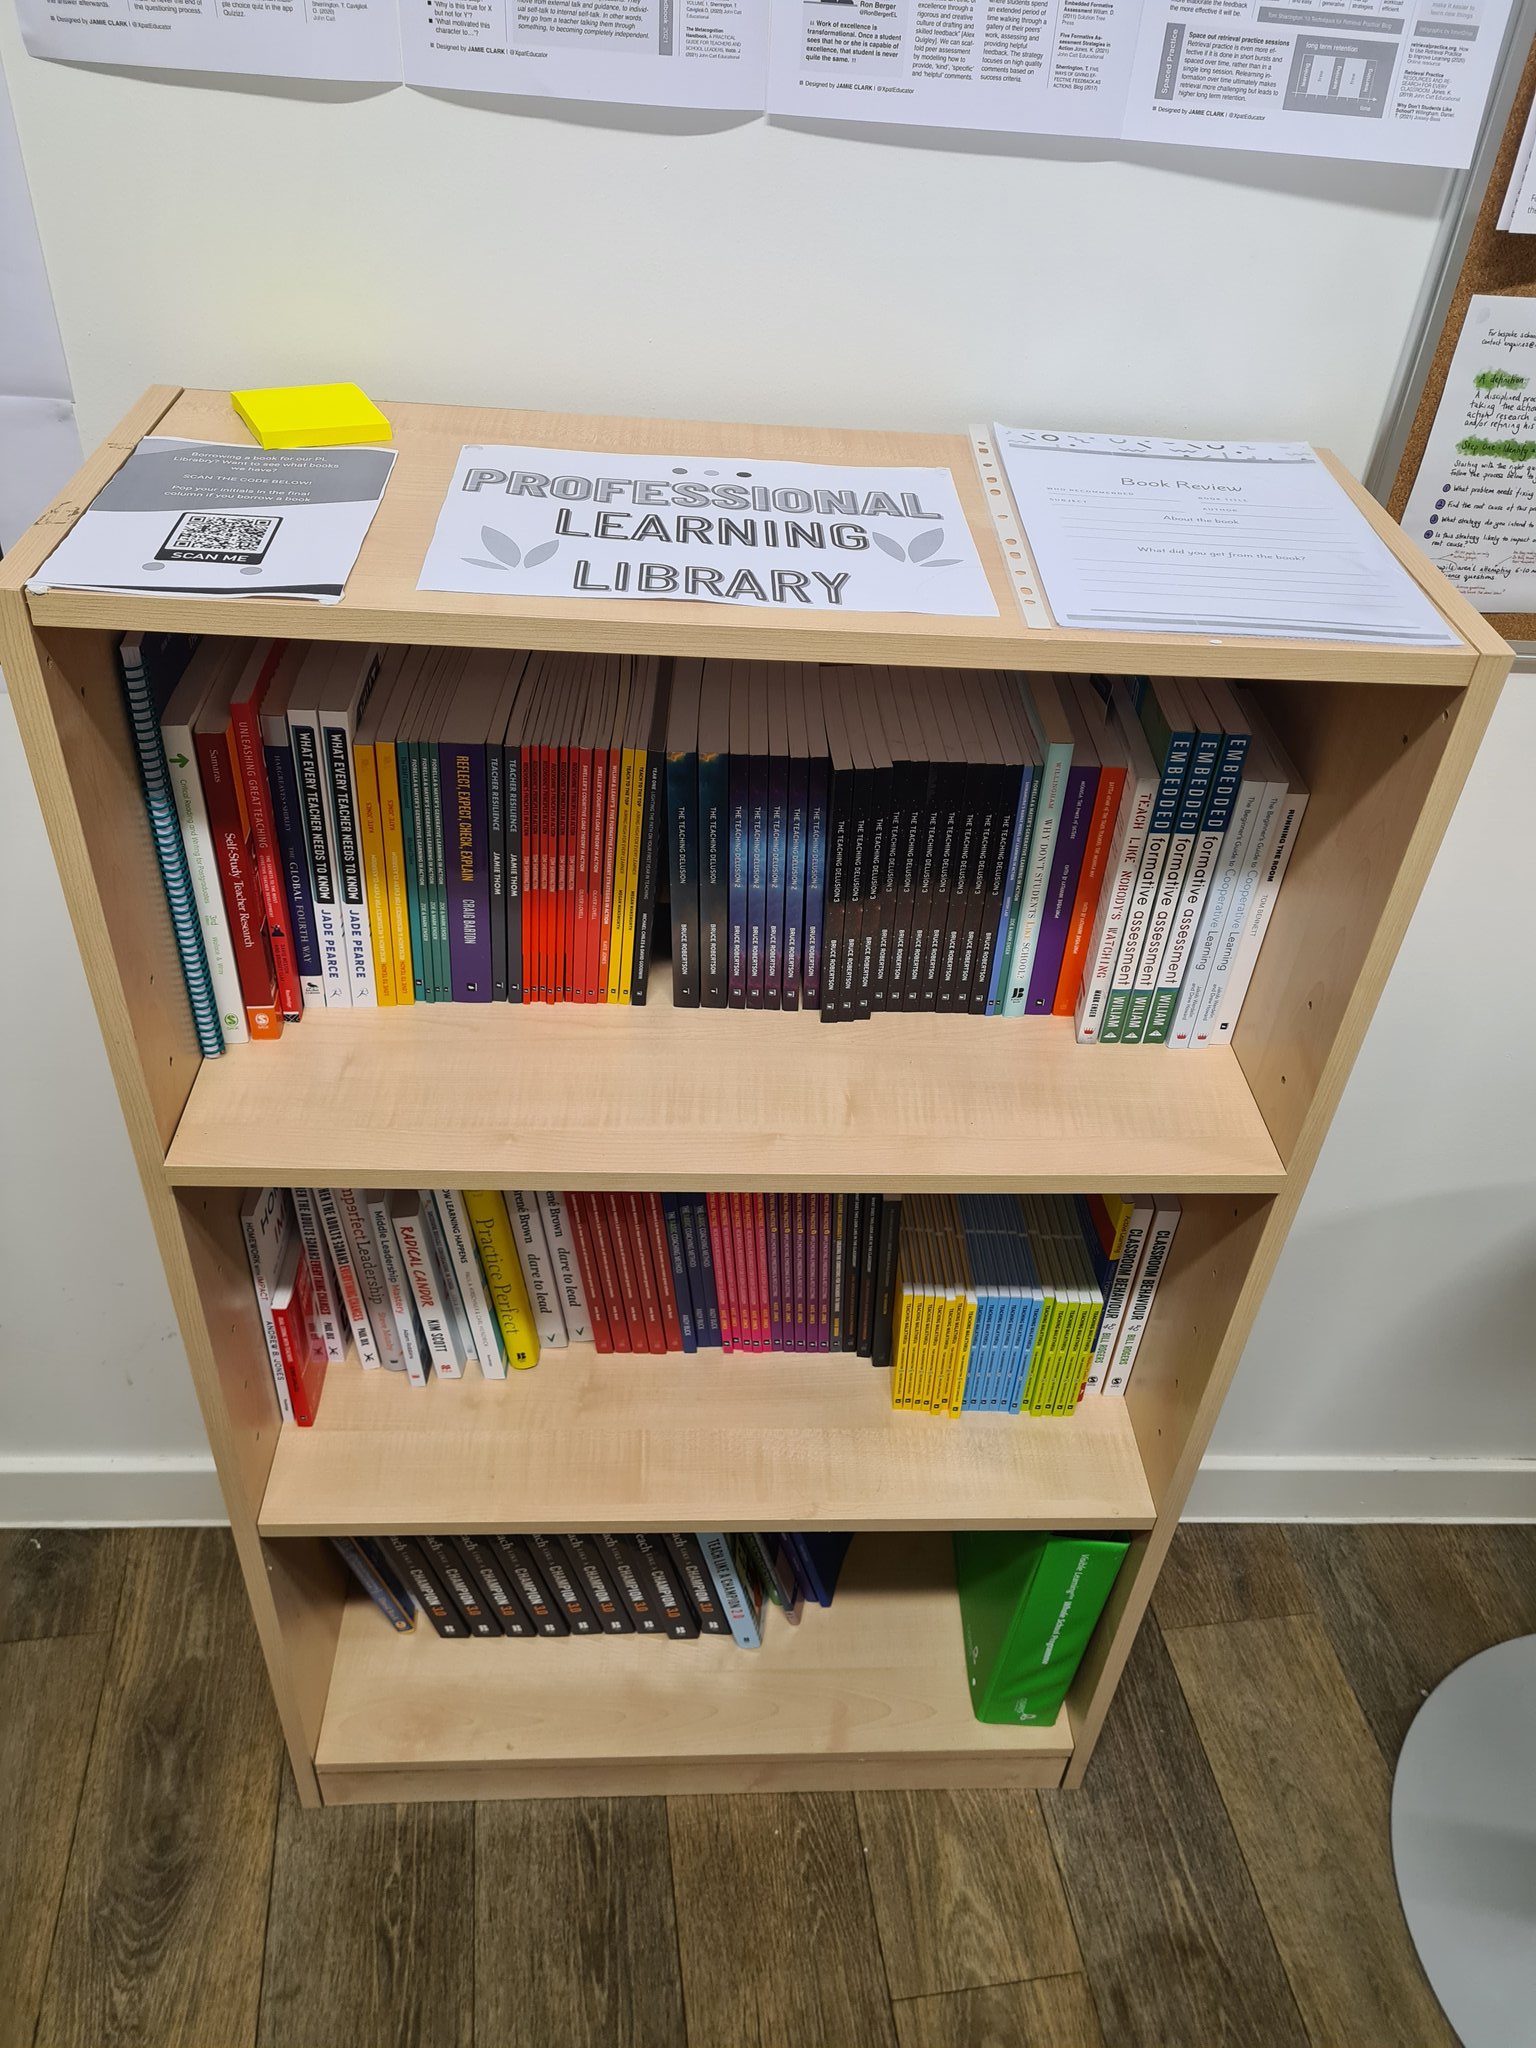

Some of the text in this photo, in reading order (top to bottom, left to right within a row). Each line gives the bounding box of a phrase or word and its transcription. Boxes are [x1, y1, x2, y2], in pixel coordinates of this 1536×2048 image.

[875, 2, 896, 10] Berger
[1218, 34, 1240, 42] retrieval
[1241, 36, 1264, 44] practice
[1161, 29, 1178, 94] Spaced Practice
[192, 452, 242, 460] Borrowing
[462, 468, 944, 520] PROFESSIONAL
[1121, 477, 1242, 492] Book Review
[1462, 501, 1471, 509] the
[1470, 486, 1494, 495] problem
[1515, 488, 1534, 500] fixing
[554, 508, 869, 551] LEARNING
[171, 552, 249, 563] SCAN ME
[572, 559, 852, 605] LIBRARY
[209, 750, 221, 783] Samaras
[239, 721, 268, 848] UNLEASHING GREAT TEACHING
[491, 757, 499, 790] TEACHER
[299, 732, 330, 900] WHAT EVERY TEACHER NEEDS TO KNOW
[331, 734, 359, 900] WHAT EVERY TEACHER NEEDS TO KNOW
[456, 755, 474, 881] REFLECT, EXPECT, CHECK, EXPLAIN
[678, 822, 686, 853] TEACHING
[1042, 819, 1053, 840] WHY
[1036, 844, 1048, 871] DON'T
[1118, 741, 1190, 986] EMBEDDED formative assessment
[1140, 742, 1217, 986] EMBEDDED formative assessment
[1165, 740, 1247, 984] EMBEDDED formative assessment
[1267, 809, 1295, 882] RUNNING THE ROOM
[225, 833, 254, 948] Self-Study Teacher Research
[289, 862, 303, 901] GLOBAL
[1028, 873, 1042, 919] STUDENTS
[1096, 793, 1152, 979] TEACH LIKE NOBODY'S WATCHING
[296, 905, 309, 942] FOURTH
[321, 909, 339, 978] JADE PEARCE
[463, 899, 476, 944] CRAIG BARTON
[302, 946, 312, 962] WAY
[350, 910, 366, 978] JADE PEARCE
[1017, 942, 1030, 979] SCHOOL?
[1108, 997, 1125, 1027] WILIAM
[1128, 997, 1147, 1028] WILIAM
[1153, 994, 1172, 1025] WILIAM
[400, 1227, 434, 1307] RADICAL CANDOR
[476, 1219, 520, 1334] Practice Perfect
[528, 1253, 552, 1313] dare to lead
[1106, 1229, 1143, 1319] CLASSROOM BEHAVIOUR
[1131, 1230, 1170, 1320] CLASSROOM BEHAVIOUR
[427, 1319, 447, 1352] KIM SCOTT
[410, 1569, 440, 1605] CHAMPION
